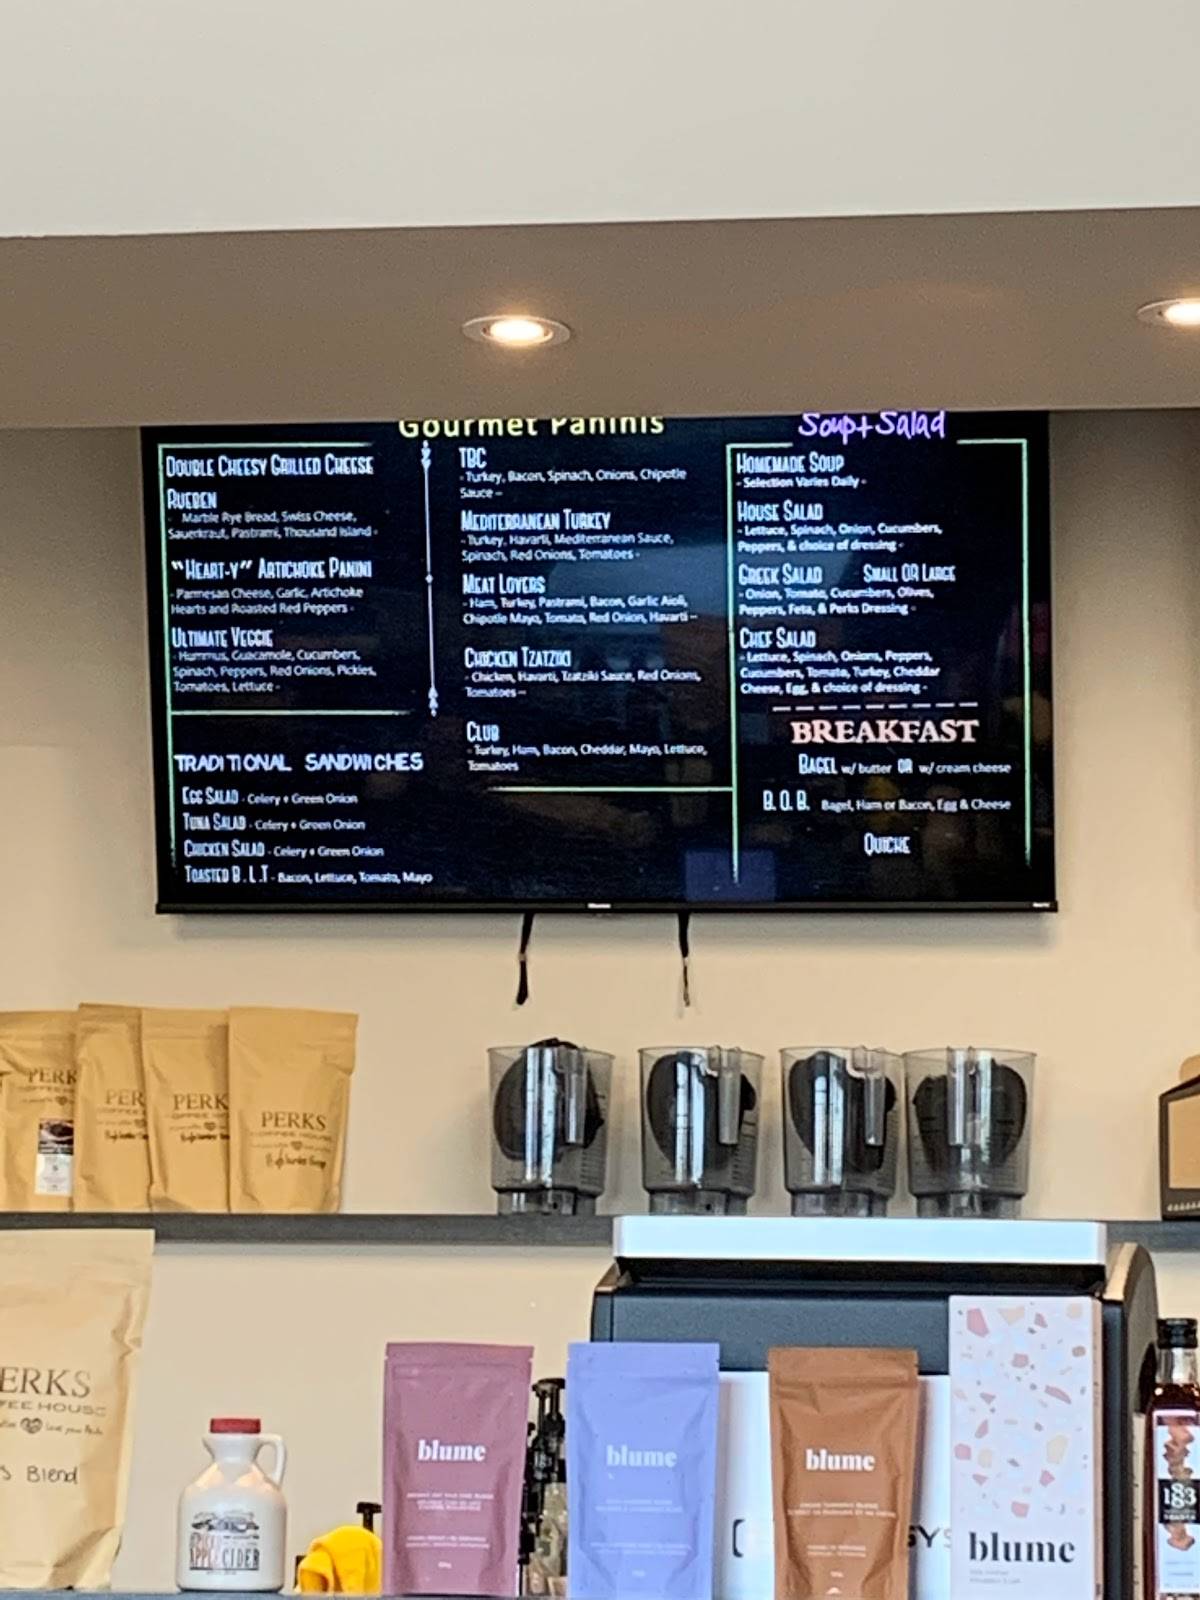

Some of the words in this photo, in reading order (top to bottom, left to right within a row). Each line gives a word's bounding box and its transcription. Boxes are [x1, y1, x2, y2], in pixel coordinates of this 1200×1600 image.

[399, 418, 537, 438] Gourmet
[166, 456, 214, 477] DOUBLE
[218, 456, 266, 476] CHEESY
[270, 454, 320, 476] GRILLED
[324, 454, 374, 475] CHEESE
[459, 447, 487, 469] TBC
[809, 452, 844, 472] SOUP
[466, 472, 506, 484] Turkey,
[508, 470, 545, 483] Bacon,
[548, 470, 594, 482] Spinach,
[596, 469, 638, 481] Onions,
[743, 478, 793, 489] Selection
[460, 489, 493, 498] Sauce
[222, 512, 242, 525] Rye
[244, 512, 279, 523] Bread,
[313, 512, 356, 523] Cheese,
[738, 501, 779, 522] HOUSE
[783, 500, 823, 521] SALAD
[563, 508, 611, 530] TURKEY
[638, 533, 674, 545] Sauce,
[799, 541, 834, 551] choice
[837, 540, 848, 551] of
[850, 540, 896, 552] dressing
[510, 550, 532, 560] Red
[535, 550, 577, 561] Onions,
[579, 549, 633, 560] Tomatoes
[782, 563, 823, 584] SALAD
[463, 574, 495, 594] MEAT
[232, 588, 273, 600] Cheese,
[171, 604, 206, 615] Hearts
[208, 604, 229, 614] and
[279, 604, 300, 614] Red
[303, 603, 348, 616] Peppers
[589, 613, 609, 623] Red
[776, 628, 816, 648] SALAD
[270, 666, 292, 676] Red
[601, 671, 635, 682] Sauce,
[638, 670, 658, 681] Red
[232, 682, 273, 692] Lettuce
[465, 688, 516, 698] Tomatoes
[823, 683, 858, 693] choice
[861, 683, 872, 693] of
[875, 683, 920, 694] dressing
[467, 721, 499, 742] CLUB
[790, 719, 979, 744] BREAKFAST
[468, 761, 519, 772] Tomatoes
[799, 753, 837, 775] BAGEL
[859, 763, 891, 774] butter
[936, 764, 970, 773] cream
[972, 762, 1011, 773] cheese
[206, 787, 238, 804] SALAD
[326, 794, 358, 804] Onion
[856, 800, 881, 810] Ham
[884, 800, 895, 810] or
[971, 799, 1011, 810] Cheese
[334, 820, 365, 830] Onion
[352, 846, 384, 856] Onion
[261, 1112, 327, 1131] PERKS
[418, 1439, 486, 1462] blume
[606, 1445, 677, 1468] blume
[806, 1449, 876, 1471] blume
[969, 1531, 1075, 1563] blume
